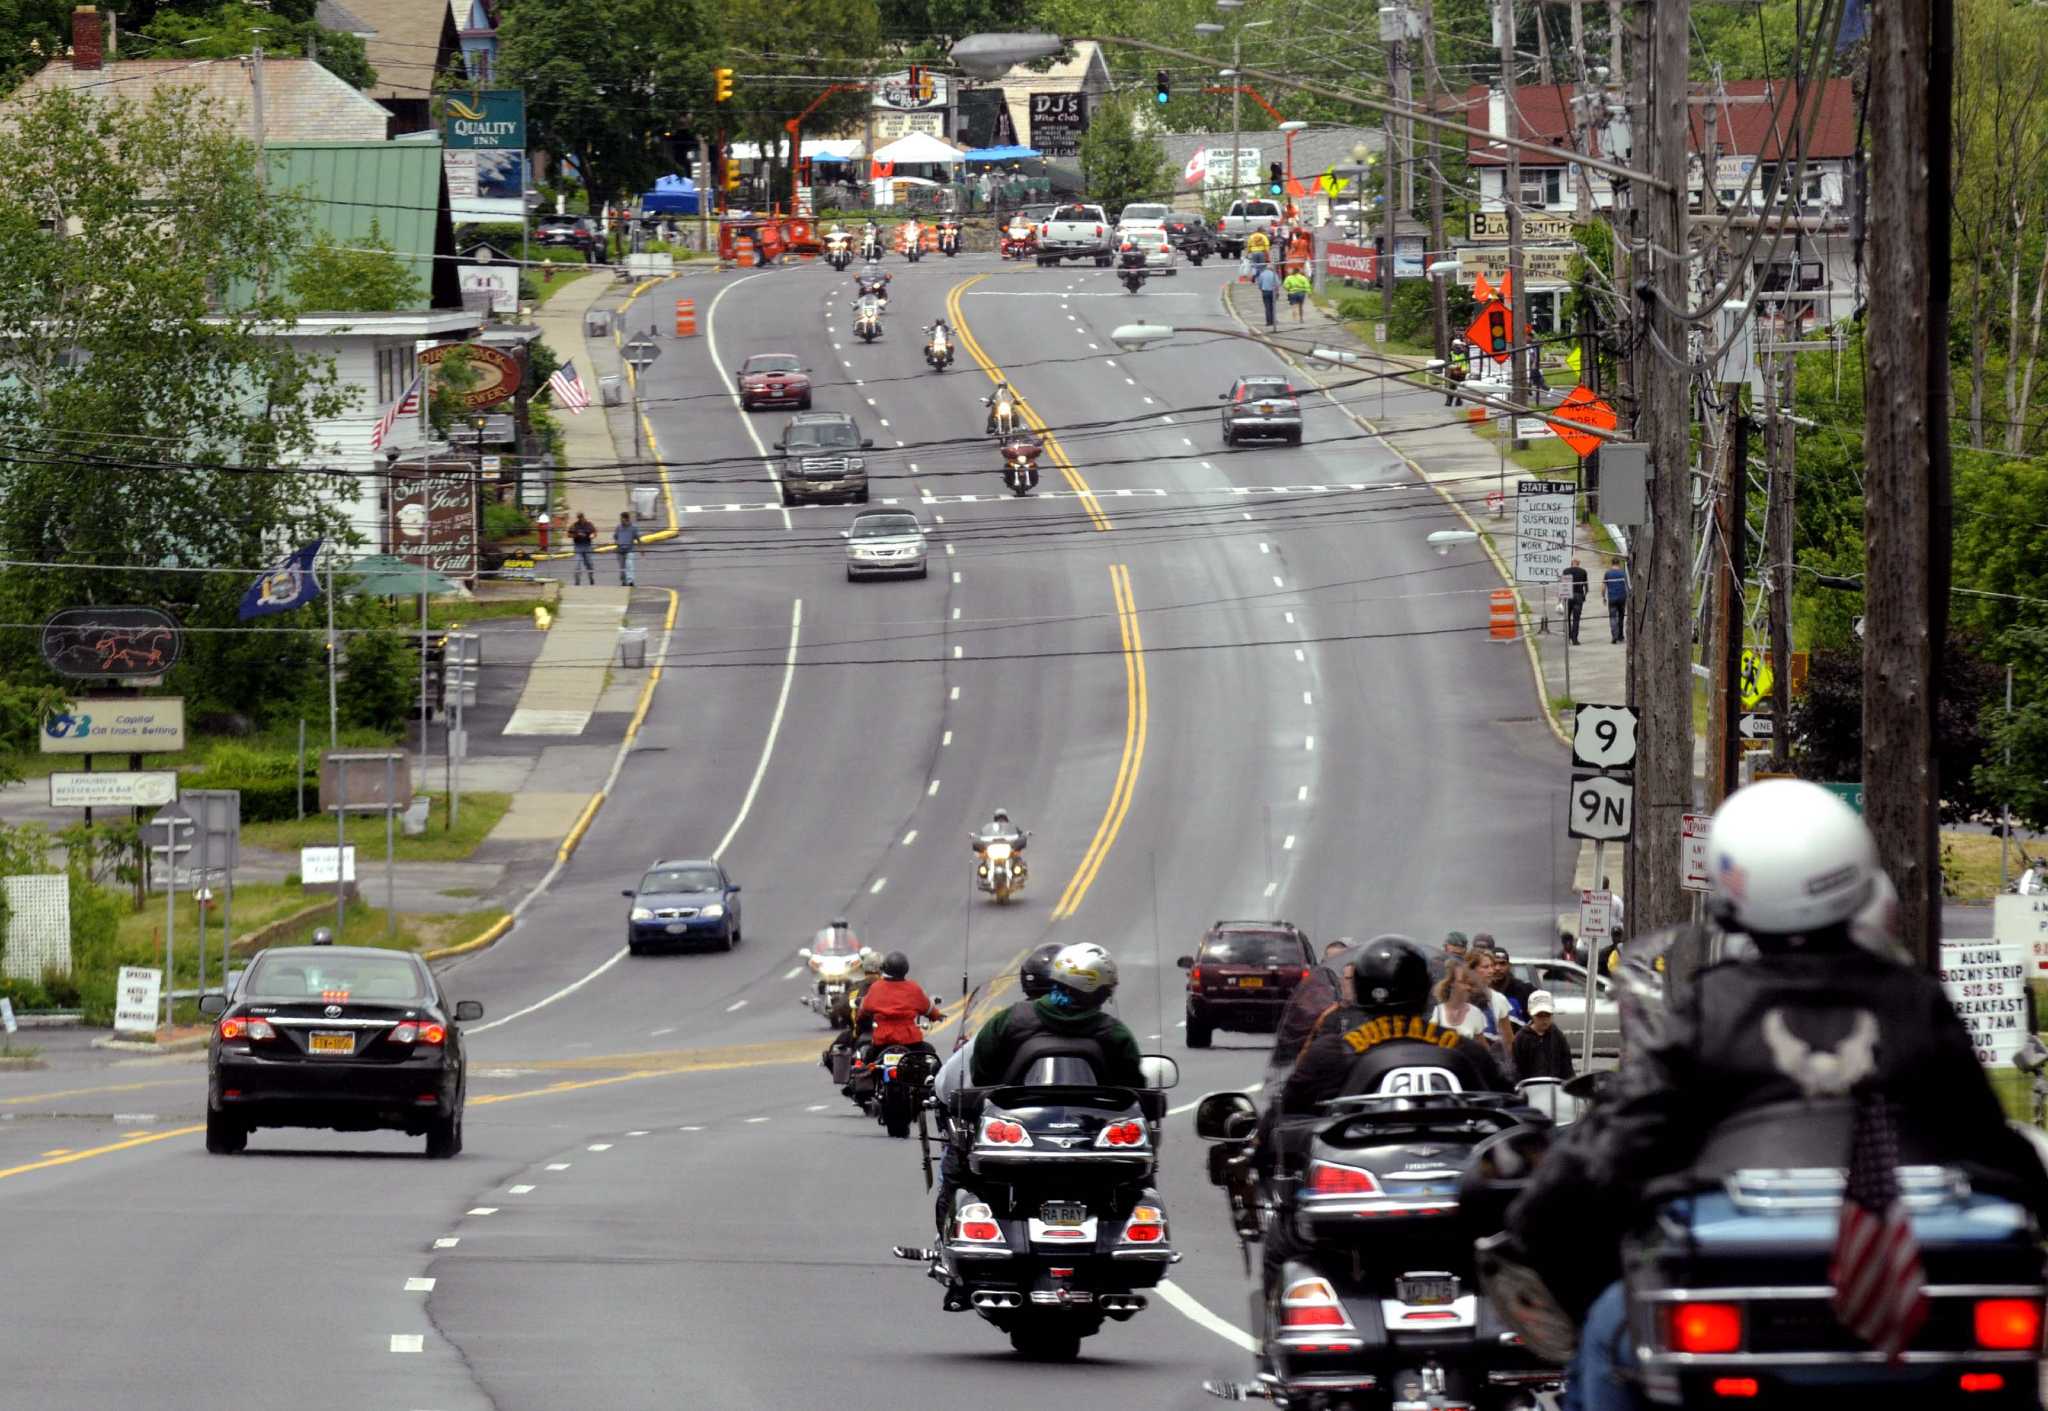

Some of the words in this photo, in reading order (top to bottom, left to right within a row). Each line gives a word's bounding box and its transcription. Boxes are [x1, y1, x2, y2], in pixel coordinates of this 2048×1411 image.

[1034, 95, 1078, 112] DJ's
[1057, 113, 1080, 121] Club
[455, 120, 516, 136] QUALITY
[474, 136, 498, 145] INN
[1474, 214, 1566, 235] BLACSMITH
[1328, 253, 1371, 273] WELCOME
[394, 472, 469, 501] Smokey
[1521, 483, 1549, 492] STATE
[1553, 484, 1574, 493] LAW
[431, 489, 470, 511] Joe's
[1529, 501, 1562, 511] LICENSE
[1522, 514, 1570, 525] SUSPENDED
[1524, 528, 1548, 538] AFTER
[1551, 529, 1568, 538] TWO
[1521, 541, 1543, 551] WORK
[433, 554, 471, 574] Grill
[1524, 553, 1562, 564] SPEEDING
[1528, 566, 1560, 577] TICKETS
[115, 714, 155, 726] Capital
[1752, 721, 1772, 731] ONE
[141, 727, 178, 737] Betting
[1595, 720, 1617, 753] 9
[1579, 790, 1625, 827] 9N
[1691, 860, 1704, 871] TIM
[1960, 950, 2003, 965] ALOHA
[1986, 965, 2023, 980] STRIP
[1963, 983, 2004, 997] $12.95
[1953, 998, 2024, 1015] REAKFAST
[1987, 1016, 2016, 1029] 7AM
[1344, 1014, 1458, 1055] BUFFALO
[1973, 1033, 1994, 1047] UD
